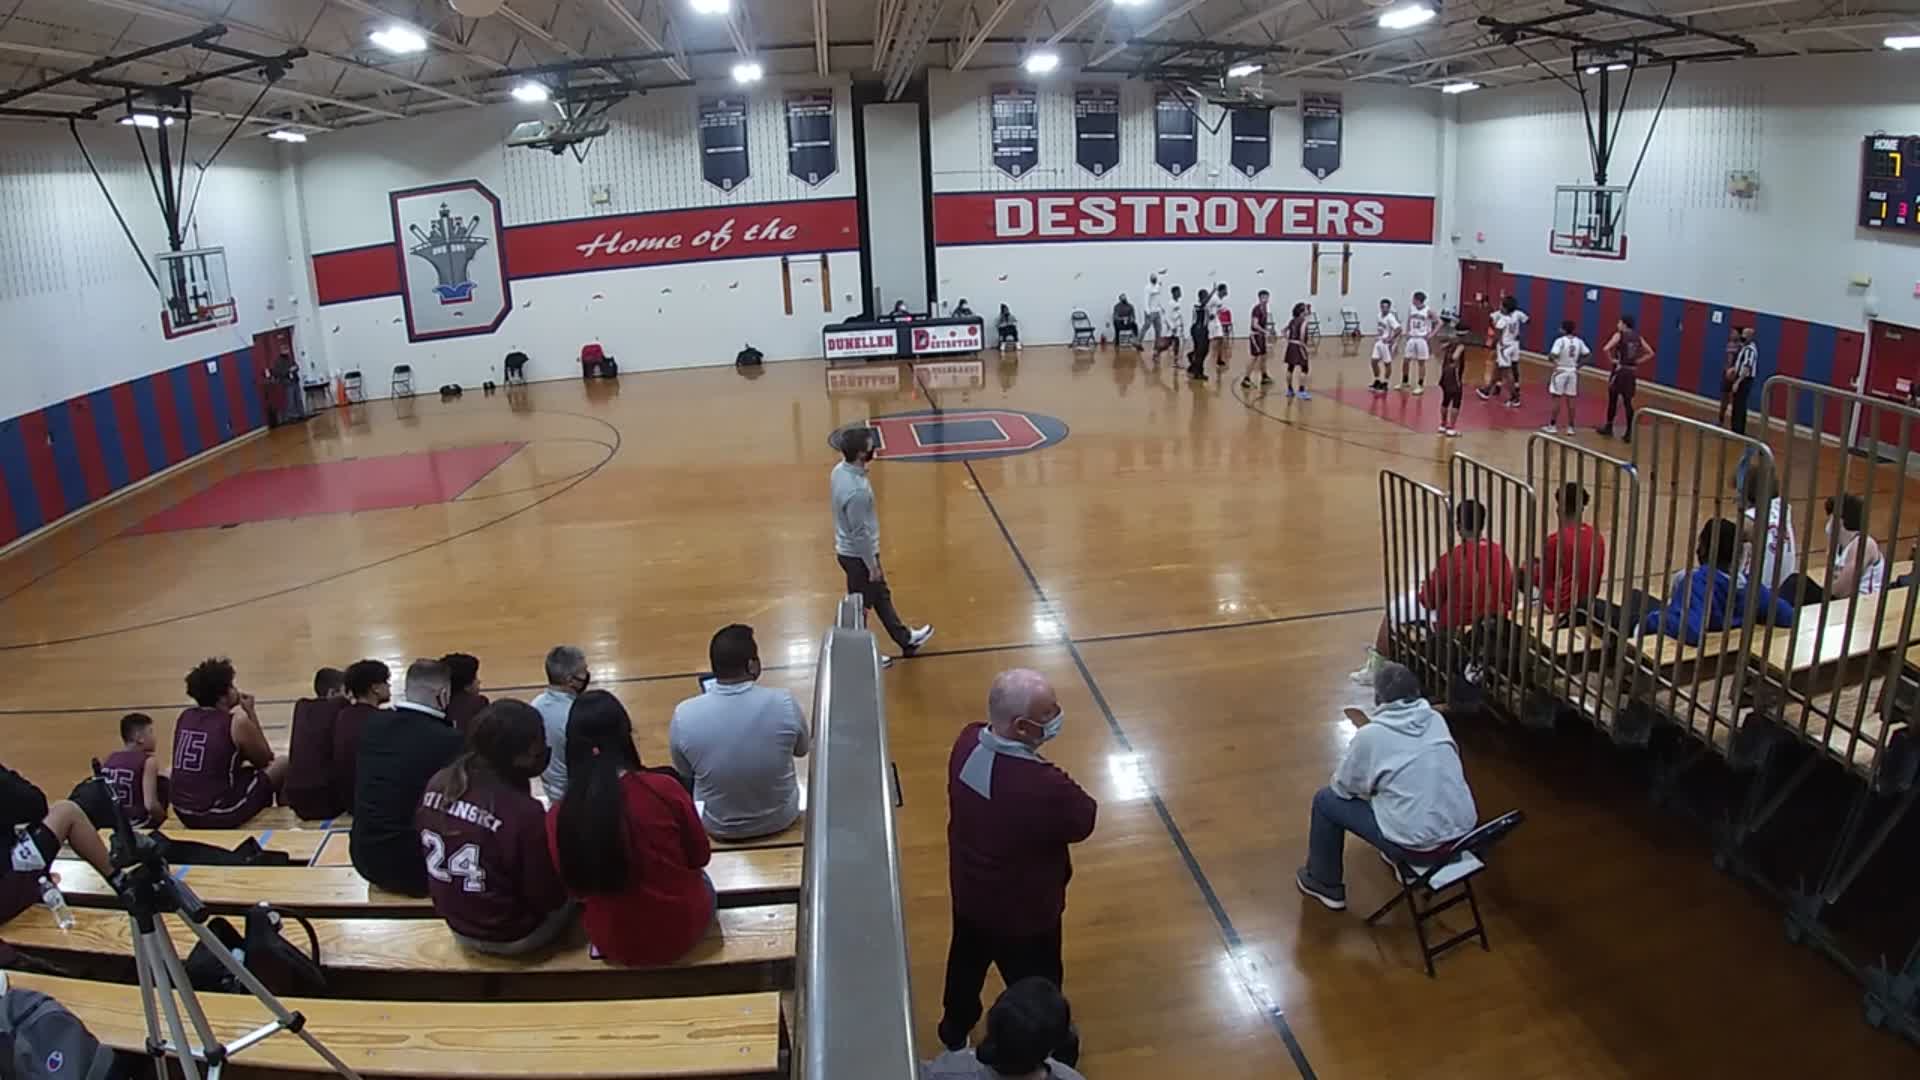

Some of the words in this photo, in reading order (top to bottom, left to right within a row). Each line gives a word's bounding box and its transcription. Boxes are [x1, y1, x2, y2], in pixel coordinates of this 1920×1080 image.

[1888, 152, 1901, 177] 7
[995, 196, 1385, 237] DESTROYERS
[576, 231, 682, 258] Home
[691, 218, 735, 252] of
[744, 217, 798, 241] the
[827, 335, 894, 351] DUNELLEN
[174, 730, 208, 772] 15
[420, 828, 486, 892] 24
